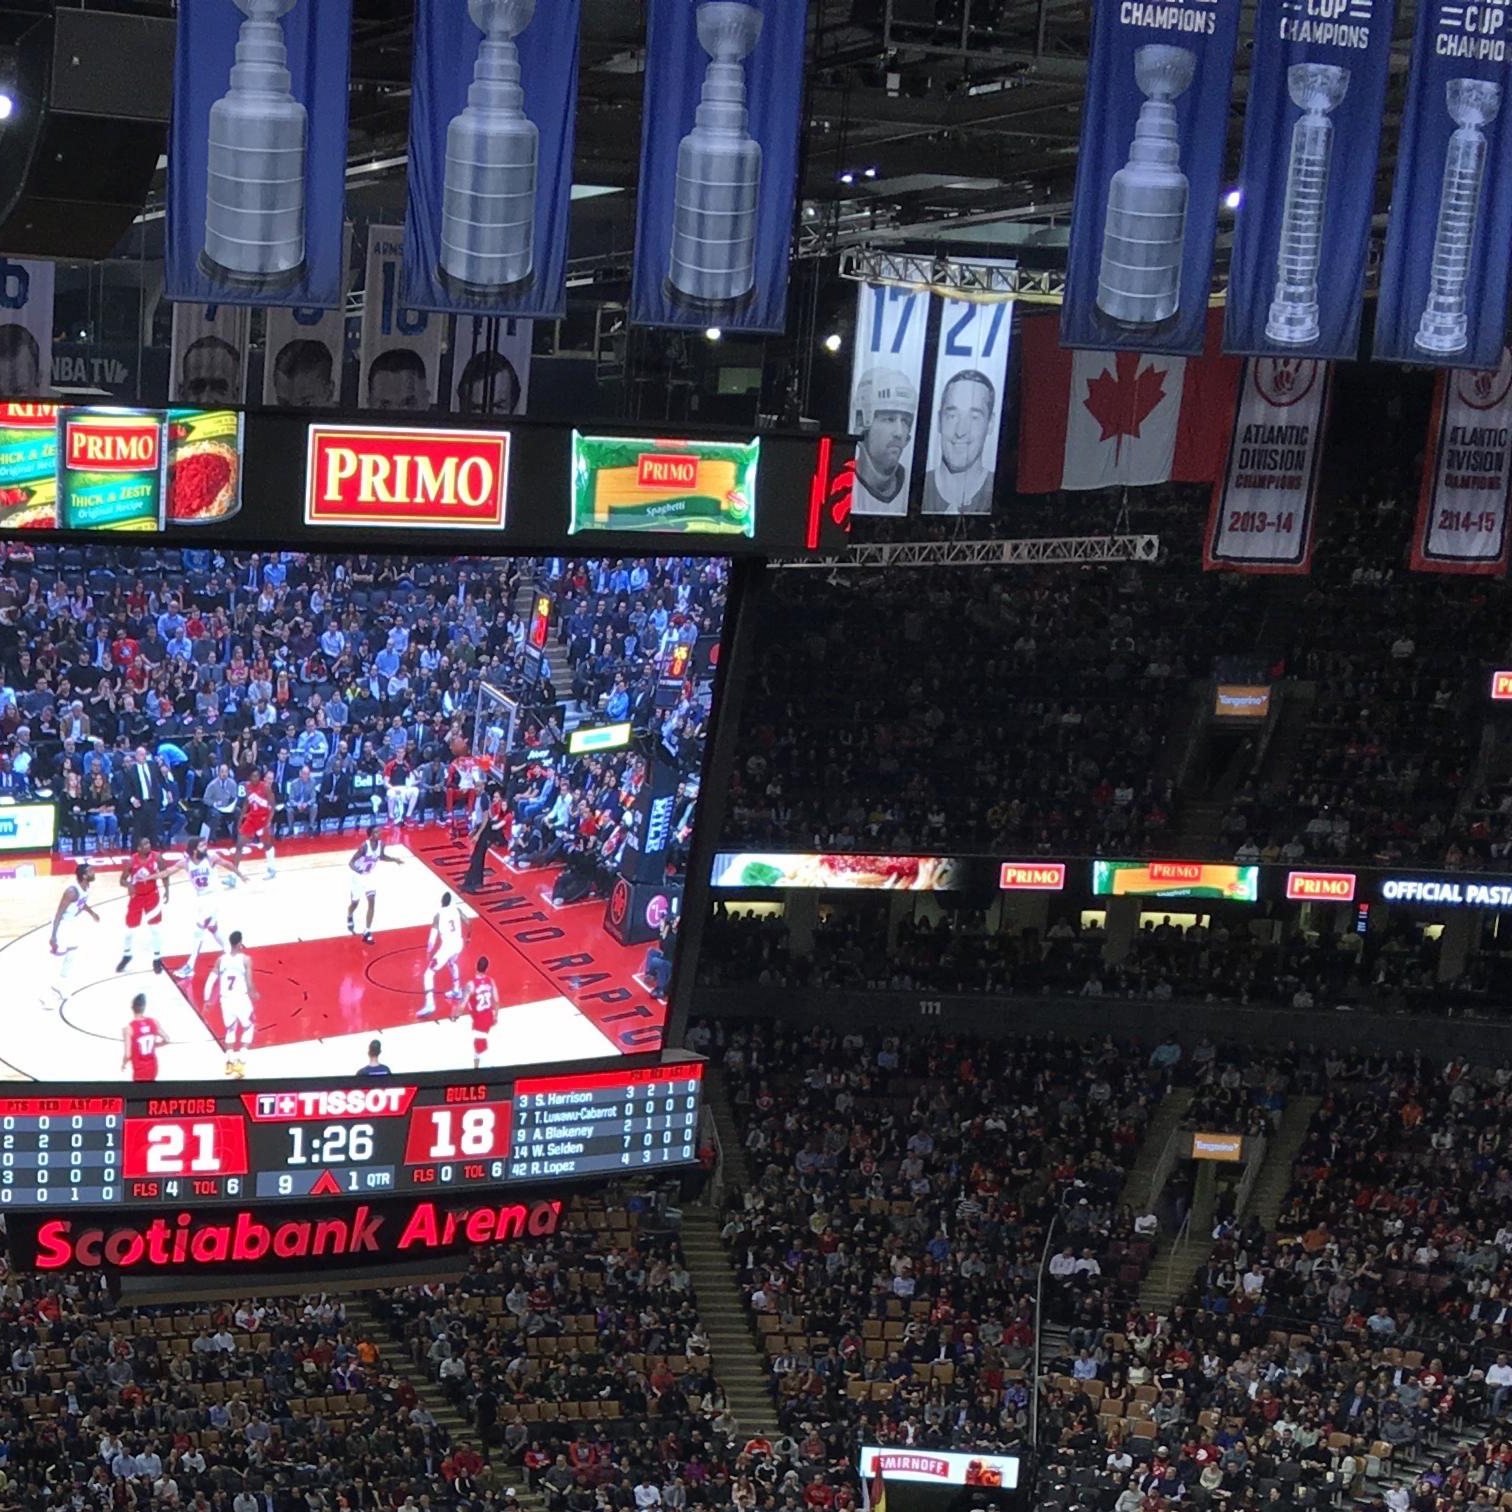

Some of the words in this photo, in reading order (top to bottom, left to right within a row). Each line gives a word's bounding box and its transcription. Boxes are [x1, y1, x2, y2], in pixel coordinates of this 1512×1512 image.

[1120, 2, 1216, 34] CHAMPIONS
[868, 287, 916, 353] 17
[944, 300, 1006, 357] 27
[1242, 424, 1309, 446] ATLANTIC
[73, 431, 153, 462] PRIMO
[324, 447, 494, 507] PRIMO
[643, 460, 695, 482] PRIMO
[71, 494, 100, 508] THICK
[120, 484, 152, 499] ZESTY
[1228, 512, 1292, 533] 2013-14
[1006, 869, 1058, 884] PRIMO
[1153, 864, 1199, 878] PRIMO
[1293, 878, 1349, 896] PRIMO
[1384, 881, 1462, 902] OFFICIAL
[298, 1087, 407, 1116] TISSOT
[445, 1085, 488, 1103] BULLS
[519, 1095, 529, 1108] 3
[548, 1091, 593, 1106] Harrison
[148, 1098, 217, 1116] RAPTORS
[519, 1112, 527, 1125] 7
[429, 1107, 496, 1158] 18
[545, 1124, 594, 1141] Blakeney
[146, 1123, 221, 1174] 21
[286, 1123, 375, 1165] 1:26
[514, 1146, 528, 1159] 14
[490, 1161, 503, 1179] 6
[512, 1163, 527, 1176] 42
[544, 1160, 575, 1175] Lopez
[133, 1182, 159, 1197] FLS
[165, 1180, 179, 1197] 4
[226, 1178, 240, 1195] 6
[278, 1174, 293, 1195] 9
[348, 1171, 360, 1191] 1
[366, 1171, 391, 1187] QTR
[35, 1205, 386, 1269] Scotiabank
[396, 1200, 563, 1250] Arena
